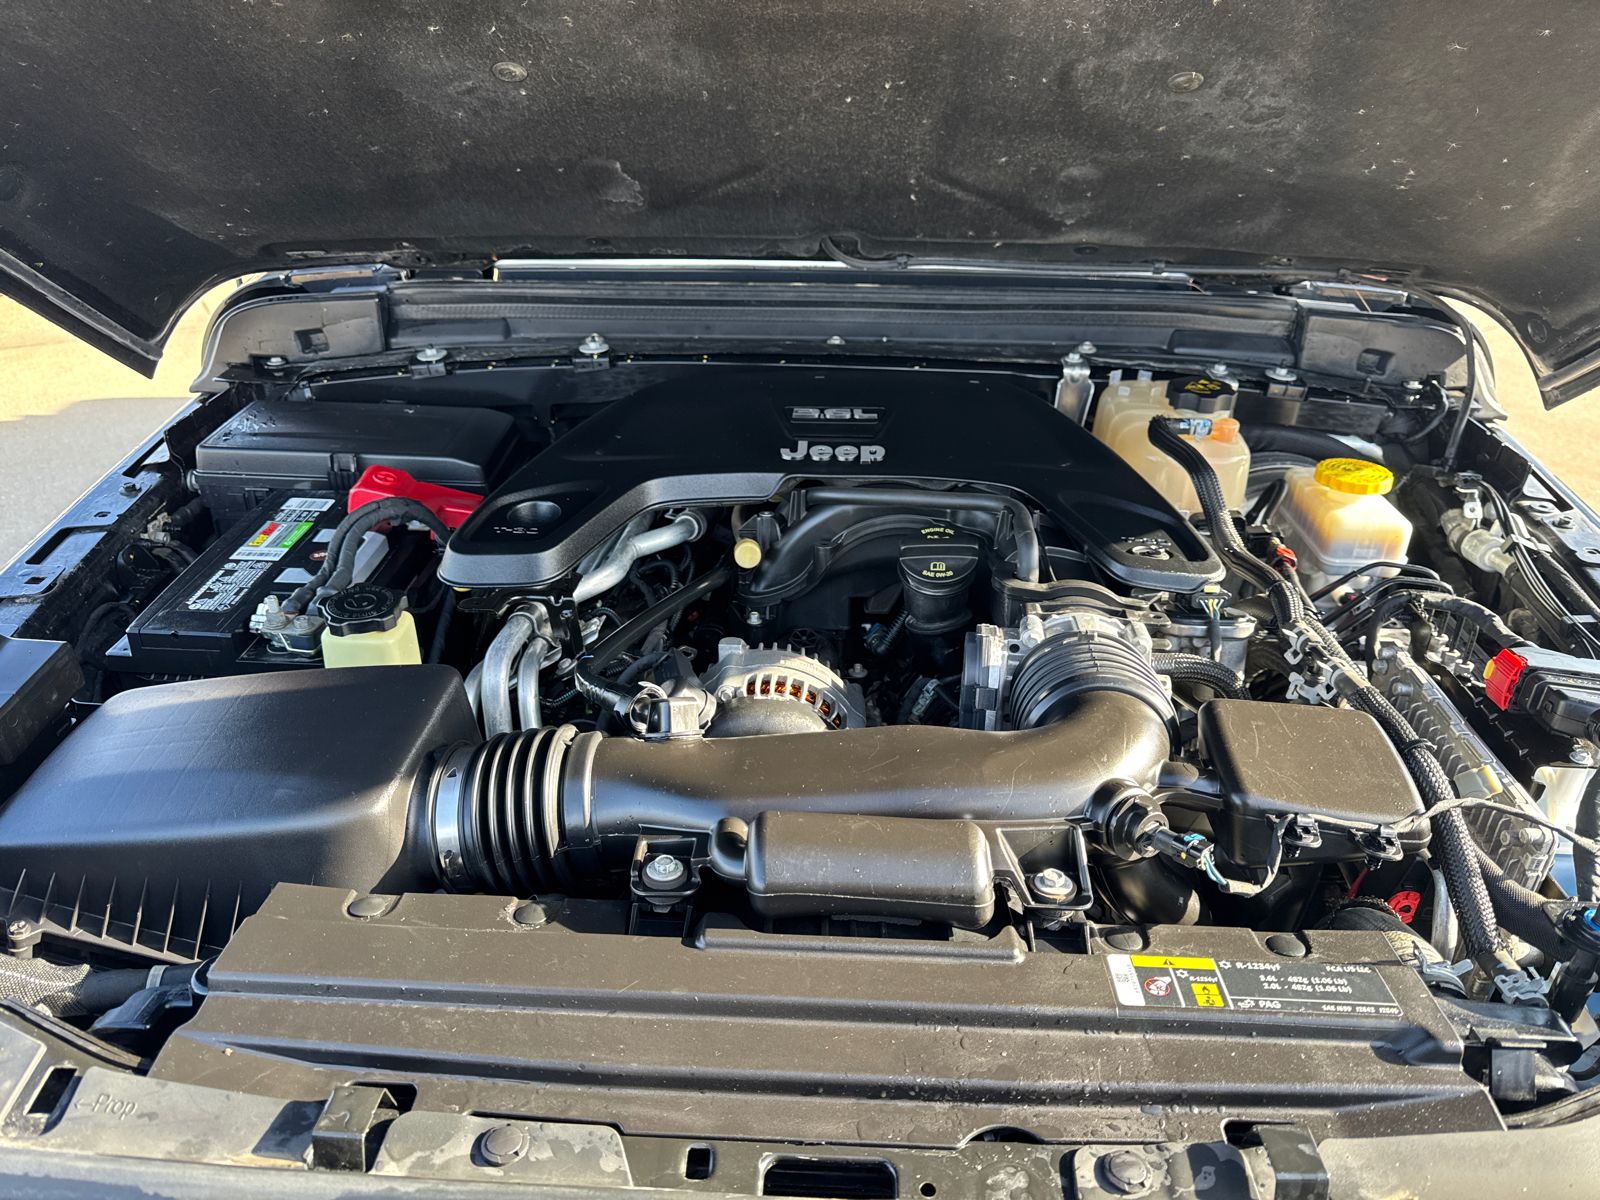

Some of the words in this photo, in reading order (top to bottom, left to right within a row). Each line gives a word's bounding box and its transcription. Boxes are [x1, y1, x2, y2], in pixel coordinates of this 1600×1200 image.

[792, 408, 878, 420] 3.6L
[780, 440, 886, 465] Jeep
[921, 527, 945, 535] ENGINE
[945, 528, 955, 536] OIL
[1235, 962, 1281, 971] R-1234yf
[1262, 982, 1282, 990] 2.0L
[1258, 1000, 1282, 1009] PAG
[92, 1092, 138, 1121] Prop
